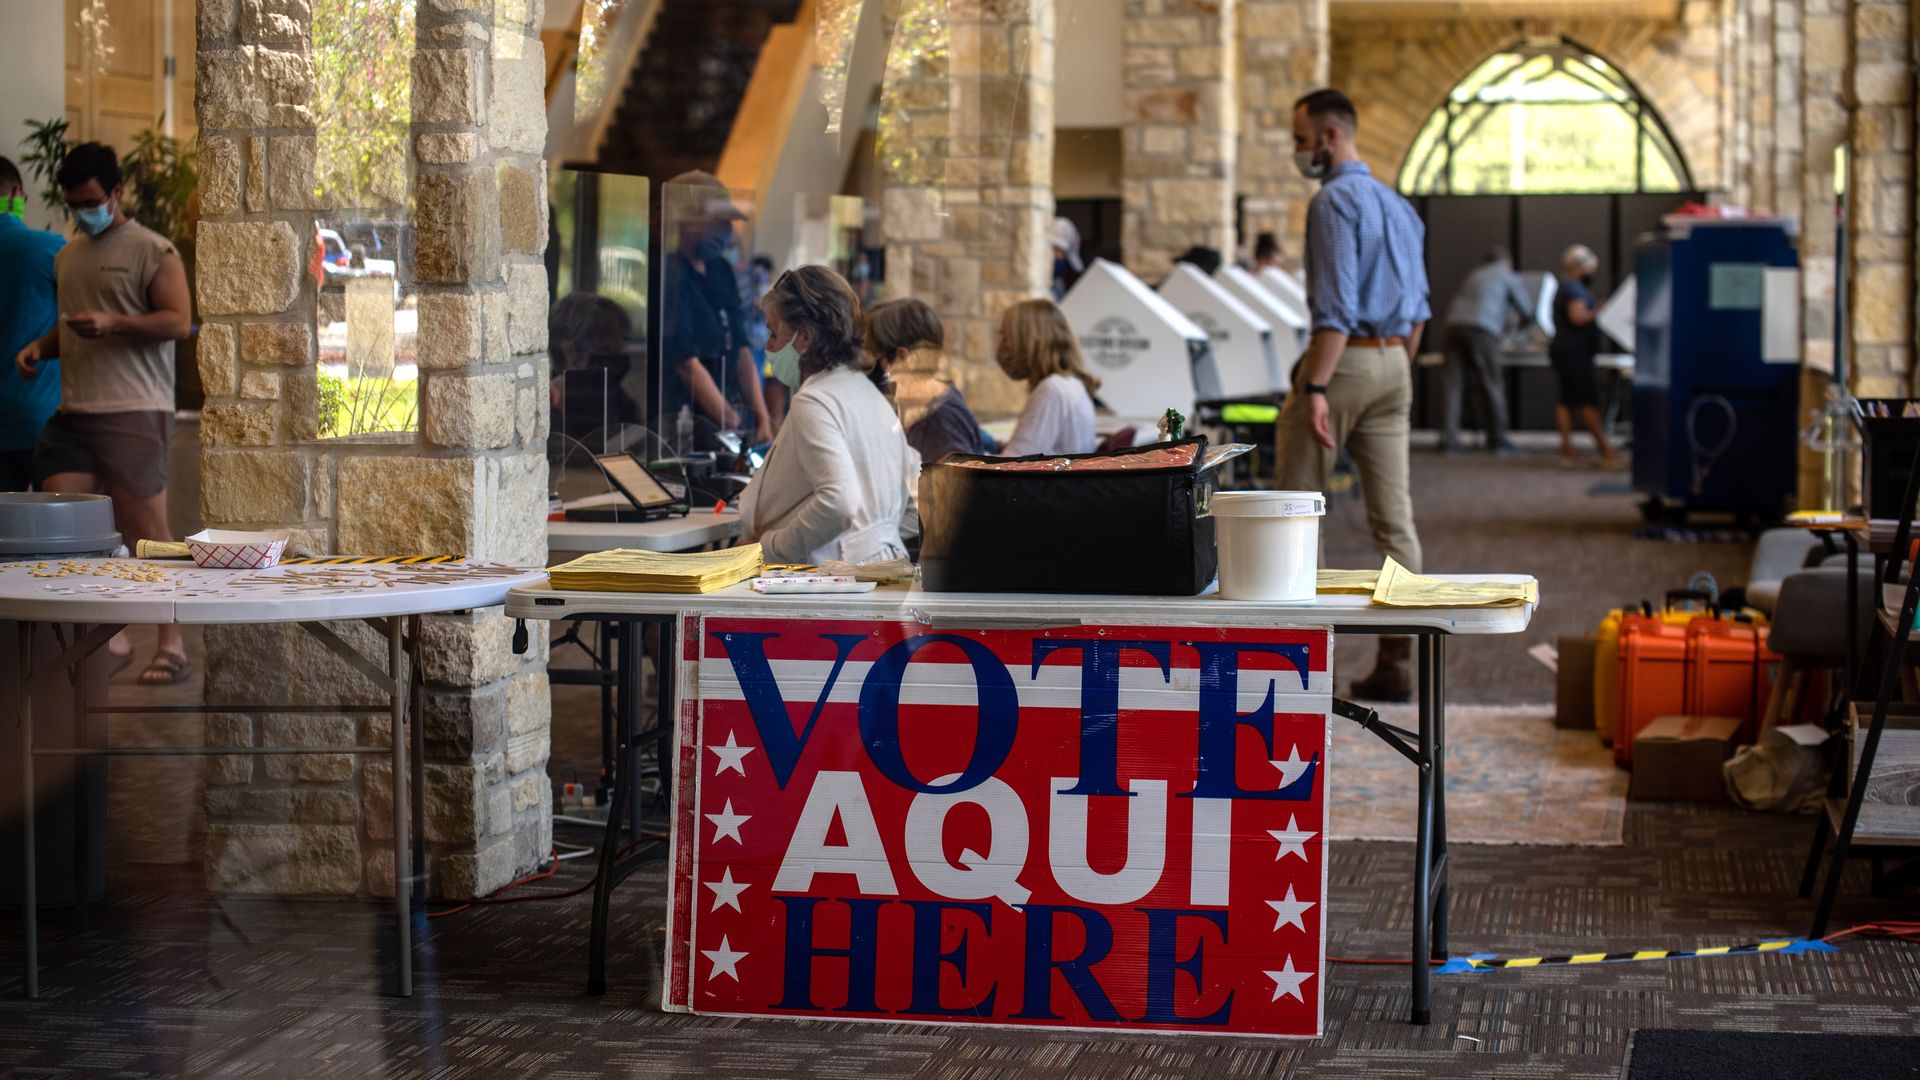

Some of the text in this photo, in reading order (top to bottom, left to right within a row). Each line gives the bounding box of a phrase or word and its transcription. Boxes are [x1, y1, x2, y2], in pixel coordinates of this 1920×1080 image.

[710, 631, 1319, 800] VOTE
[771, 771, 1231, 913] AQUI
[768, 896, 1234, 1026] HERE
